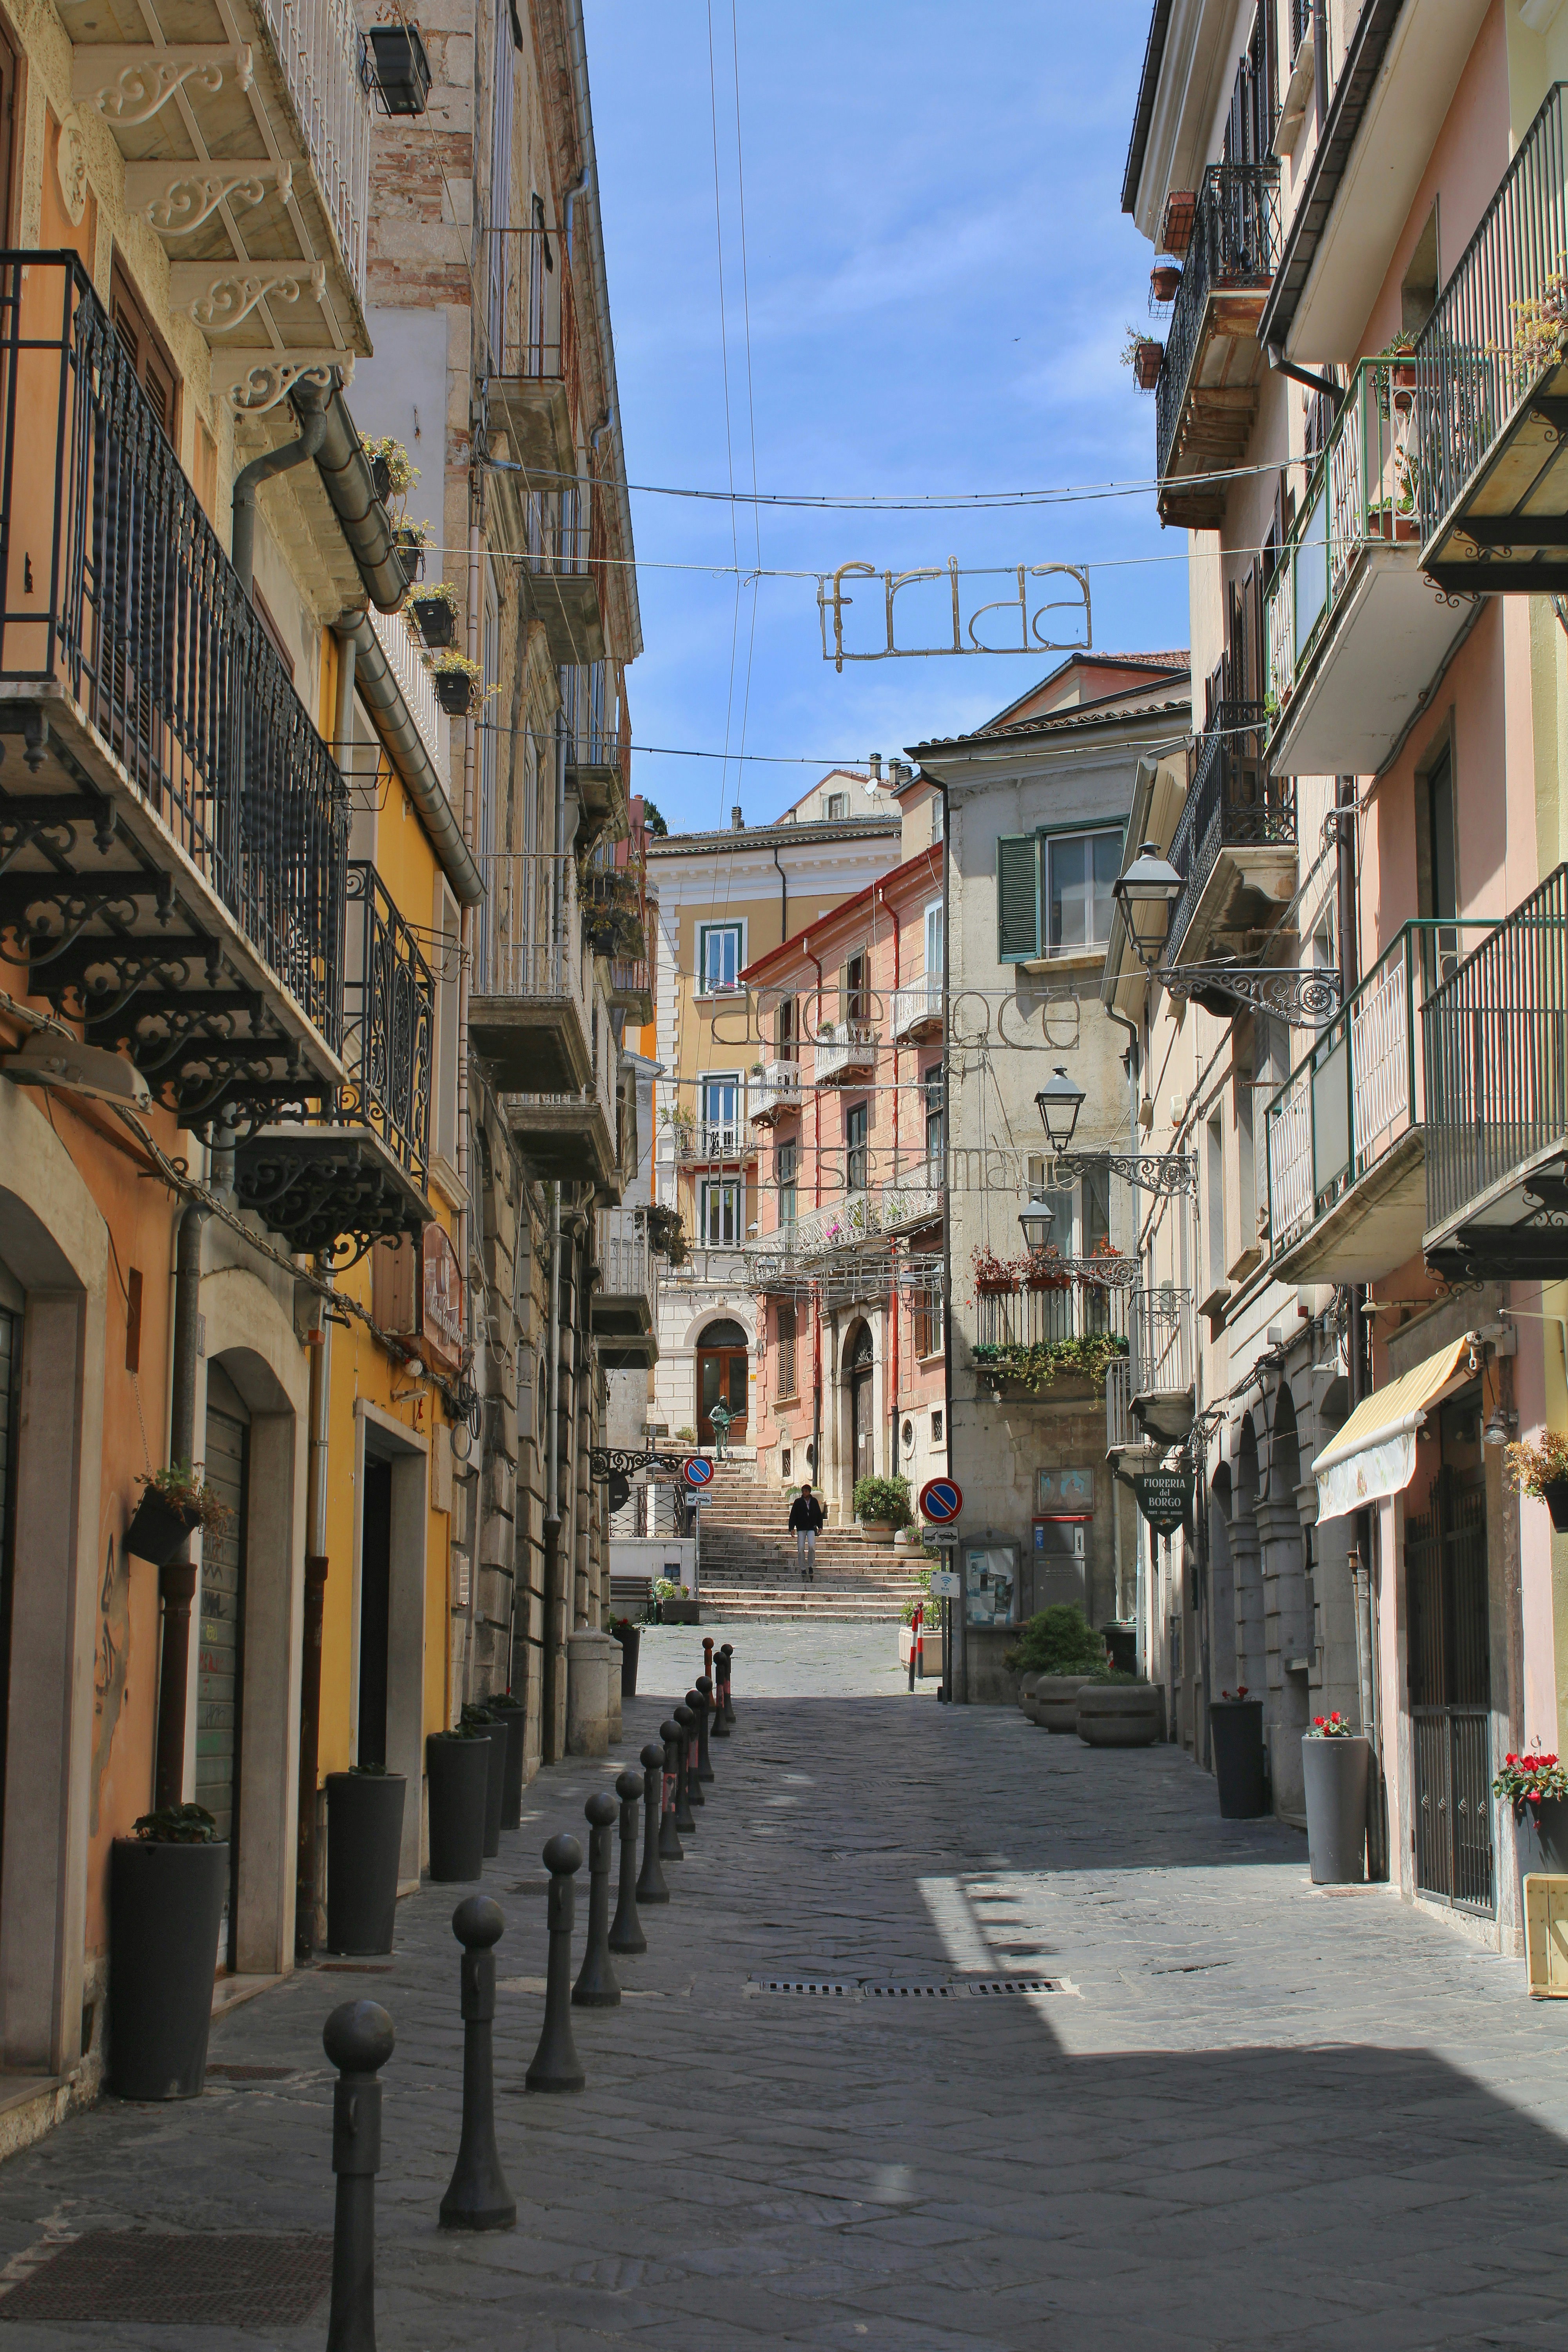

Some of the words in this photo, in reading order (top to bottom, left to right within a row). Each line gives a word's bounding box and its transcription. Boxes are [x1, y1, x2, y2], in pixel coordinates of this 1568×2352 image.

[821, 555, 1093, 673] frida
[711, 983, 884, 1049] doce
[907, 991, 1080, 1051] doce
[817, 1147, 1078, 1192] settimane
[1144, 1478, 1185, 1488] FIORERIA
[1149, 1497, 1181, 1507] BORGO
